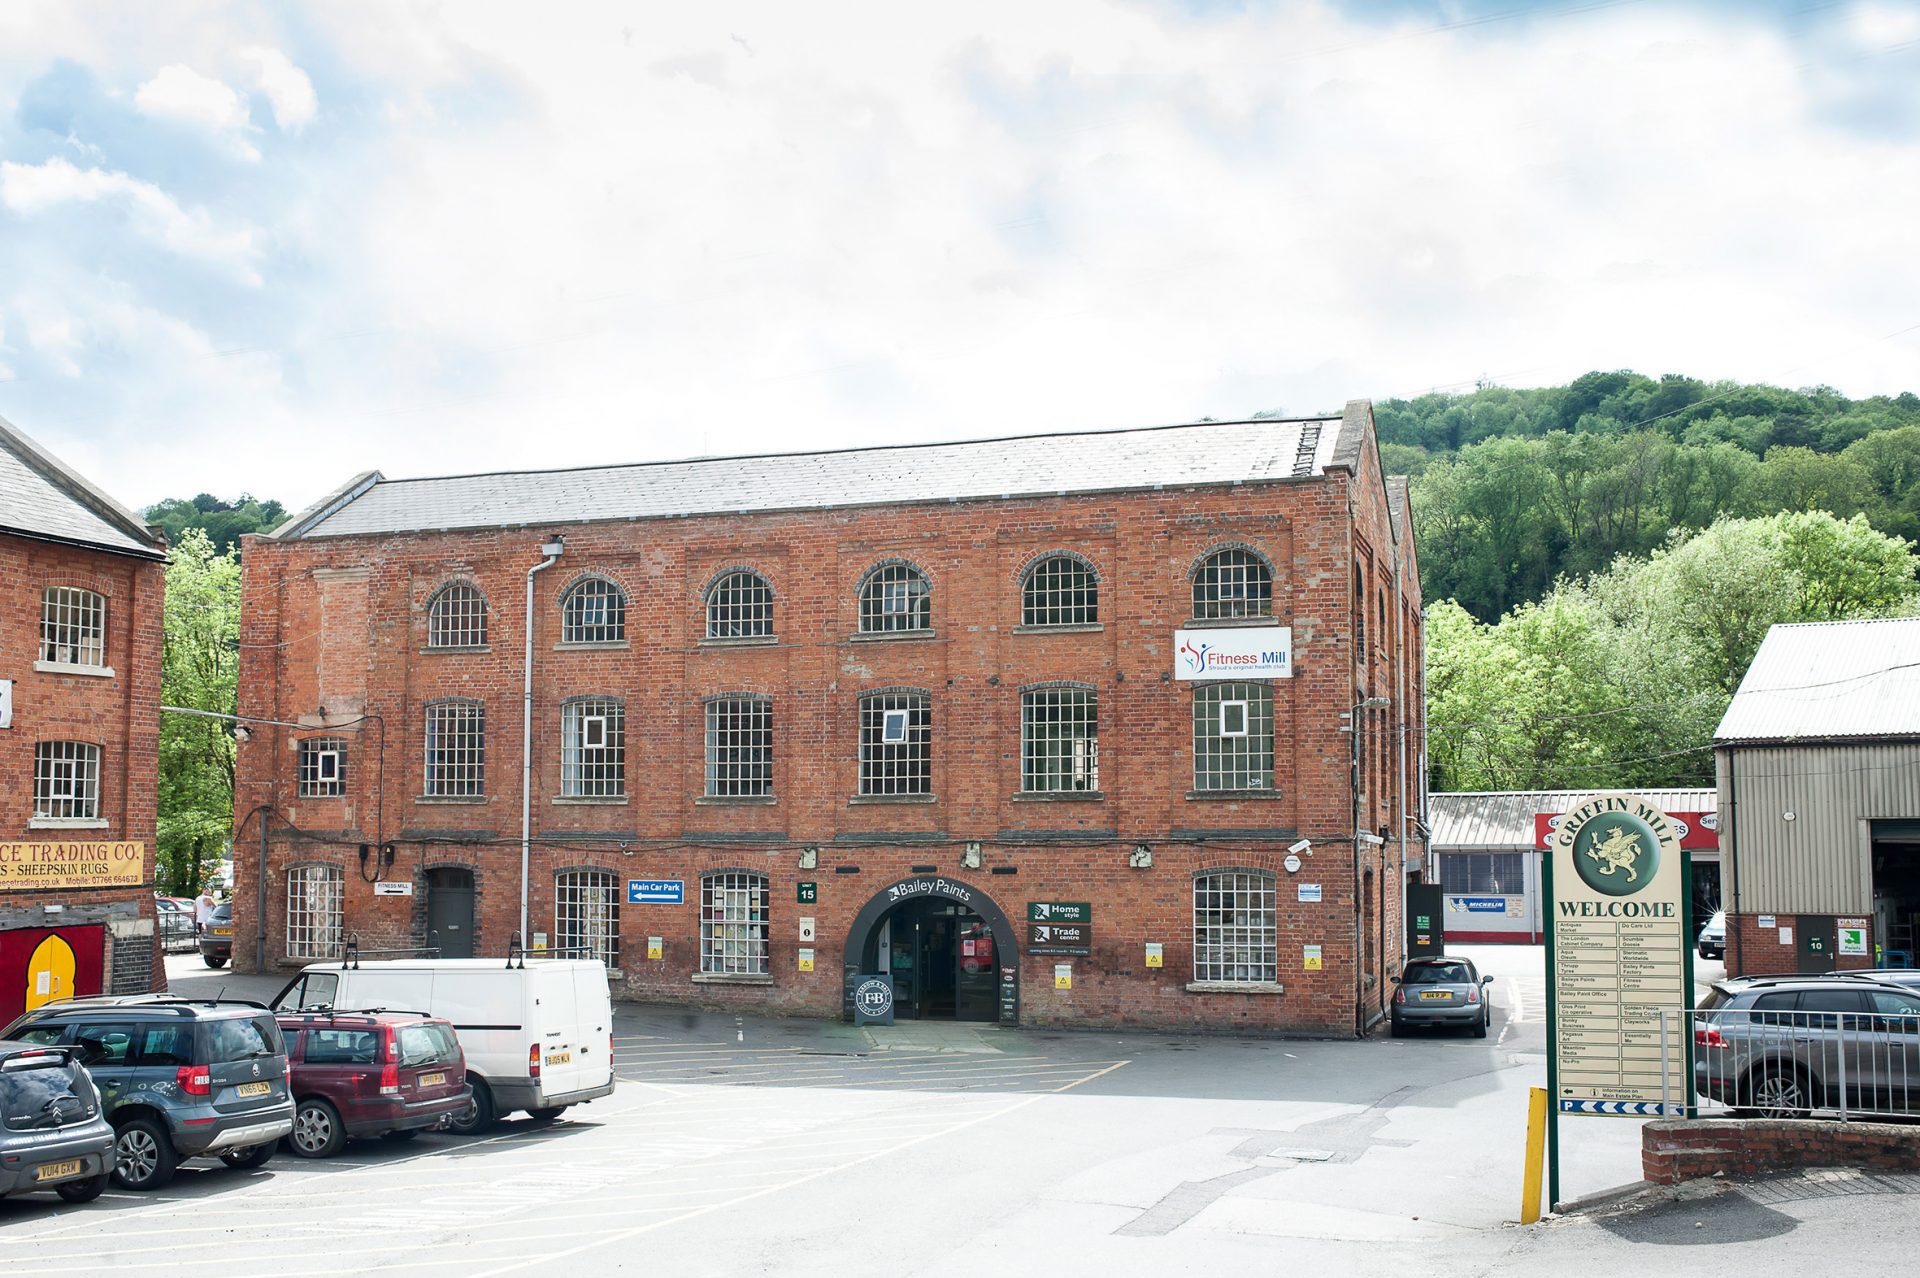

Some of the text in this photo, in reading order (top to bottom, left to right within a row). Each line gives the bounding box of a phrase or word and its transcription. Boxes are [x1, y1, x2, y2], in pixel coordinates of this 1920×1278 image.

[1208, 651, 1286, 665] Fitness Mill
[1559, 797, 1673, 848] GRIFFIN MILL
[29, 844, 108, 862] TRADING
[114, 844, 140, 861] CO.
[17, 864, 77, 876] SHEEPSKIN
[80, 863, 109, 875] RUGS
[66, 877, 91, 885] Mobile:
[92, 876, 112, 884] 07766
[114, 875, 138, 883] 664673
[631, 883, 649, 891] Main
[899, 879, 971, 901] Bailey Paints
[801, 890, 814, 899] 15
[1052, 905, 1079, 913] Home
[1559, 902, 1675, 918] WELCOME
[865, 992, 884, 1004] F&B
[239, 1084, 256, 1094] VN66
[1564, 1102, 1573, 1110] P
[42, 1163, 76, 1177] VU14 GXM
